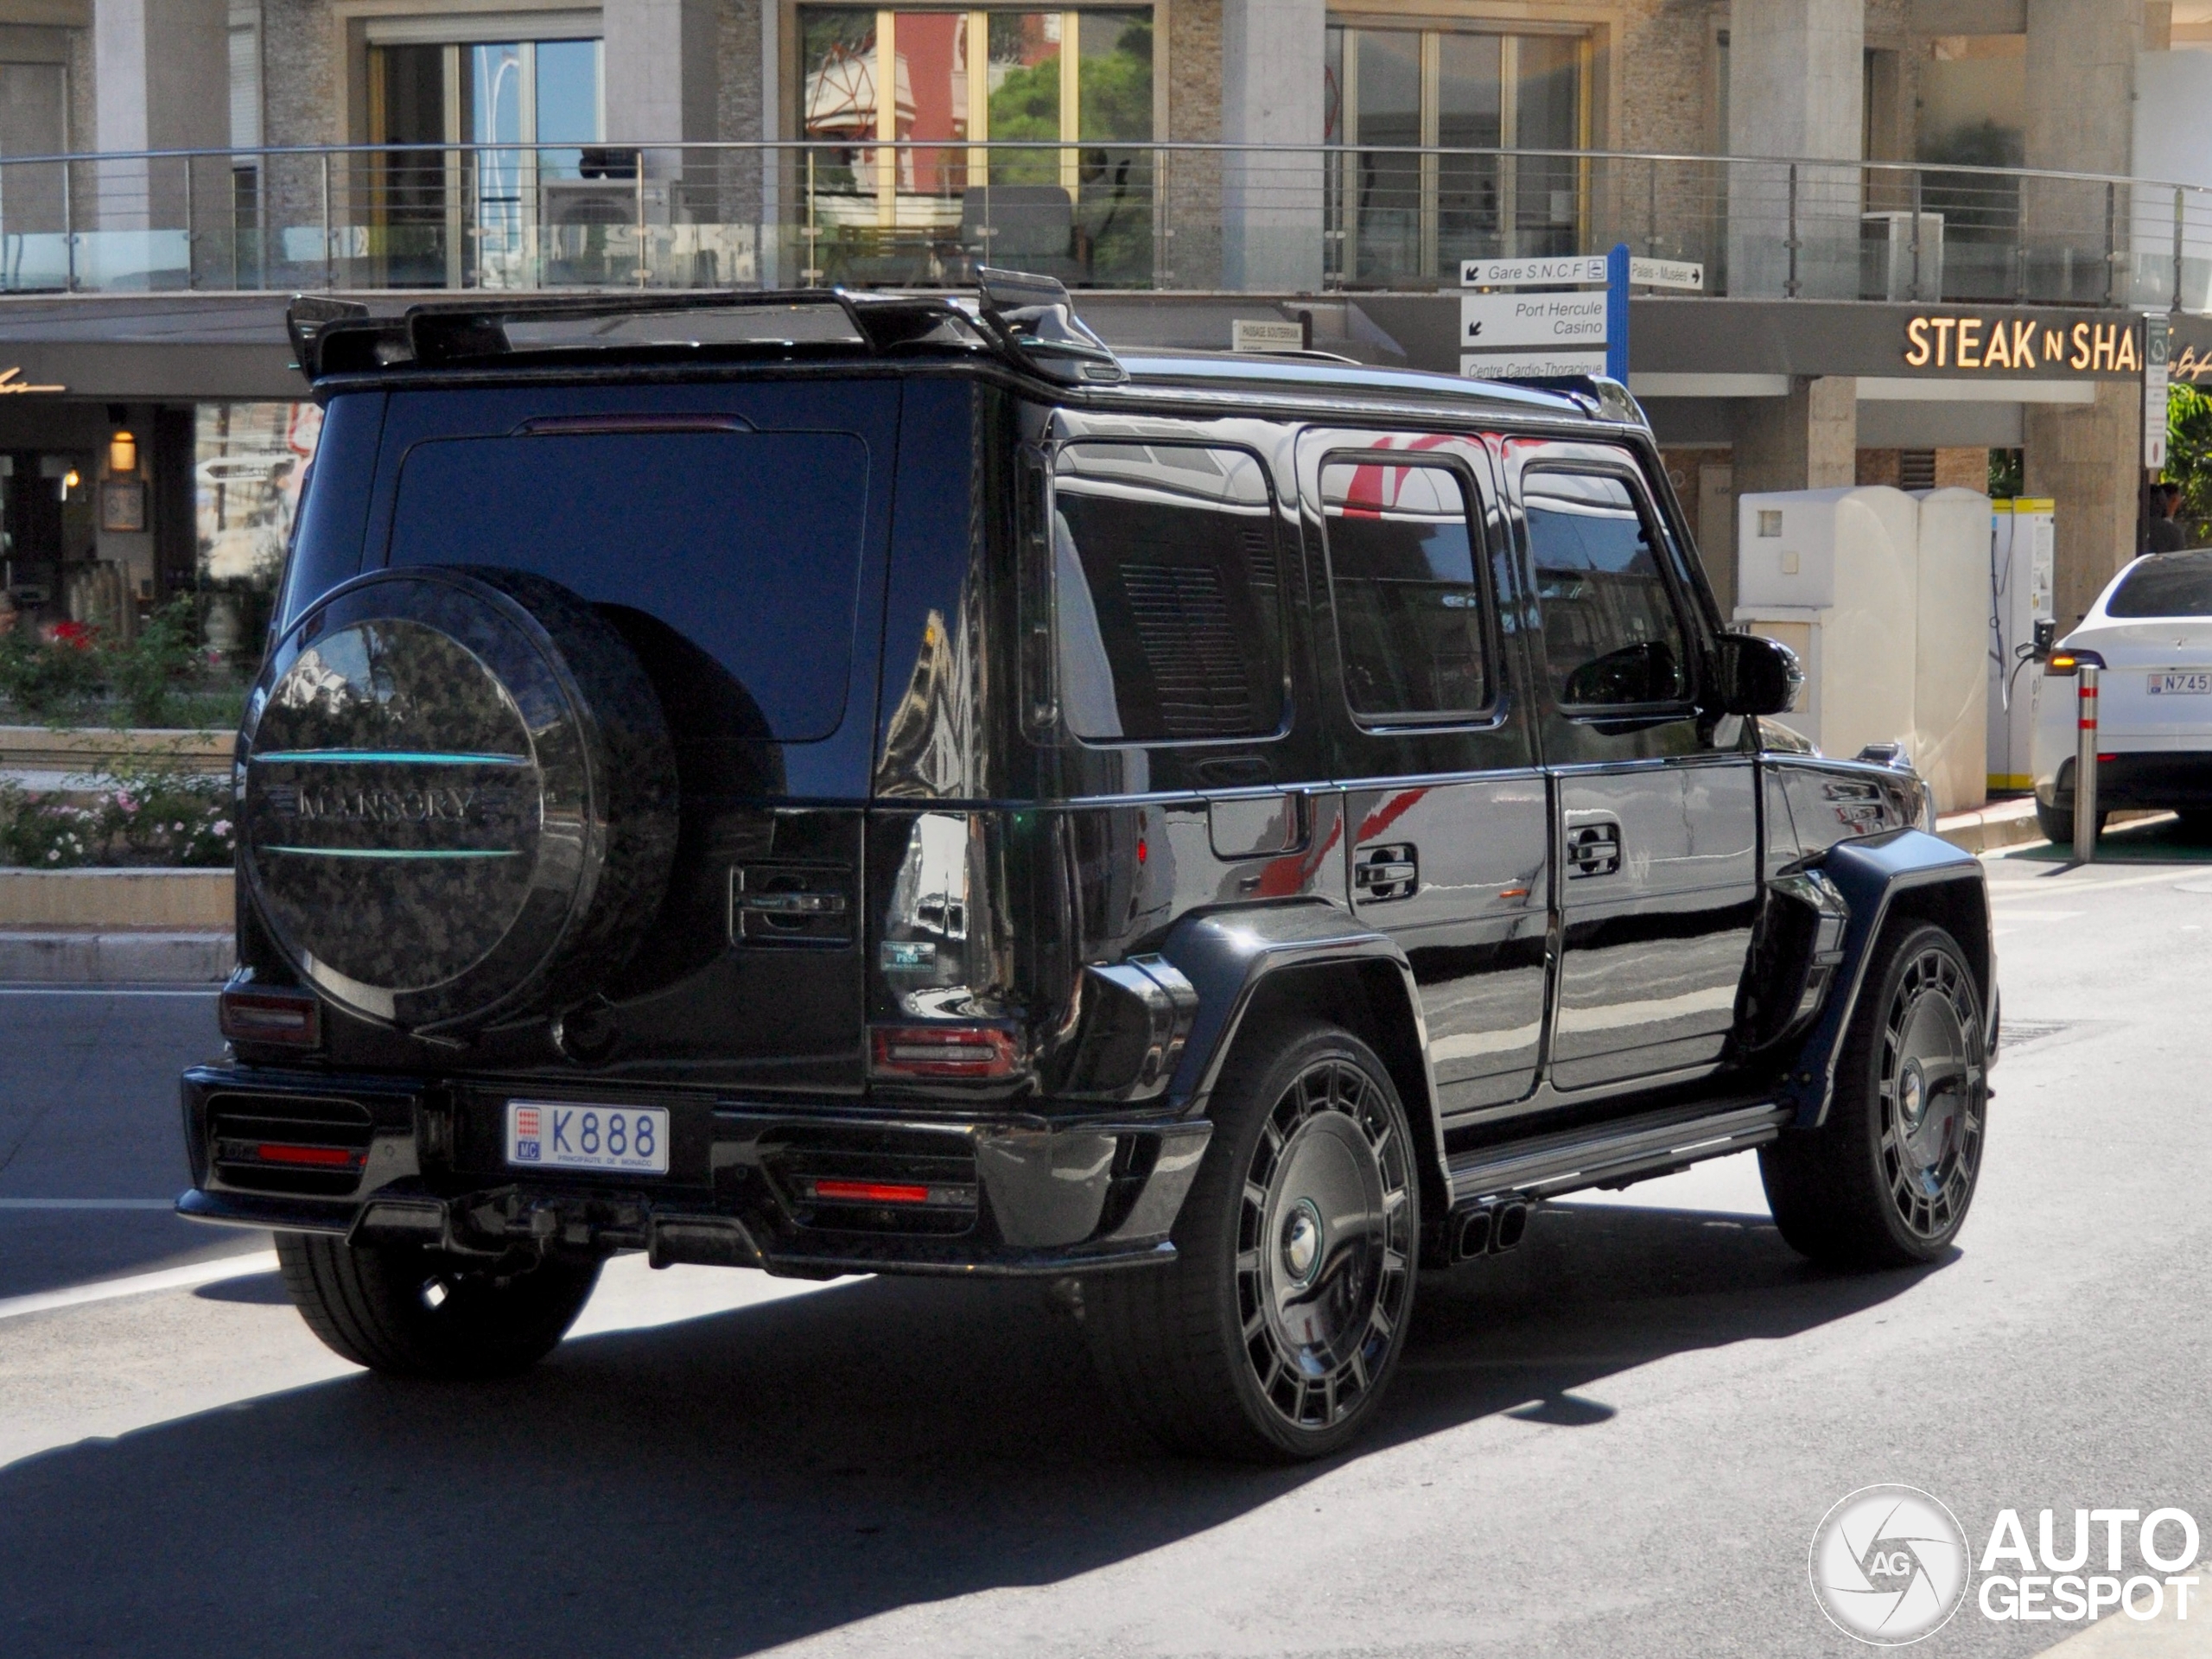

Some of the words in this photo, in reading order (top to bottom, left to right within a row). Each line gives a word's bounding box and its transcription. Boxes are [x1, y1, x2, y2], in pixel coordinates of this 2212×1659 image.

[1488, 265, 1522, 280] Gare
[1526, 264, 1582, 278] S.N.C.F
[1632, 263, 1654, 278] Palais
[1660, 266, 1688, 282] Musées
[1516, 302, 1544, 317] Port
[1548, 301, 1602, 316] Hercule
[1554, 321, 1603, 335] Casino
[1905, 317, 2037, 368] STEAK
[2044, 329, 2063, 361] N
[2070, 322, 2174, 372] SHA
[1469, 363, 1503, 378] Centre
[2165, 676, 2208, 690] N745
[298, 787, 476, 822] MANSORY
[553, 1109, 656, 1158] K888
[520, 1142, 537, 1157] MC
[621, 1158, 652, 1166] MONACO
